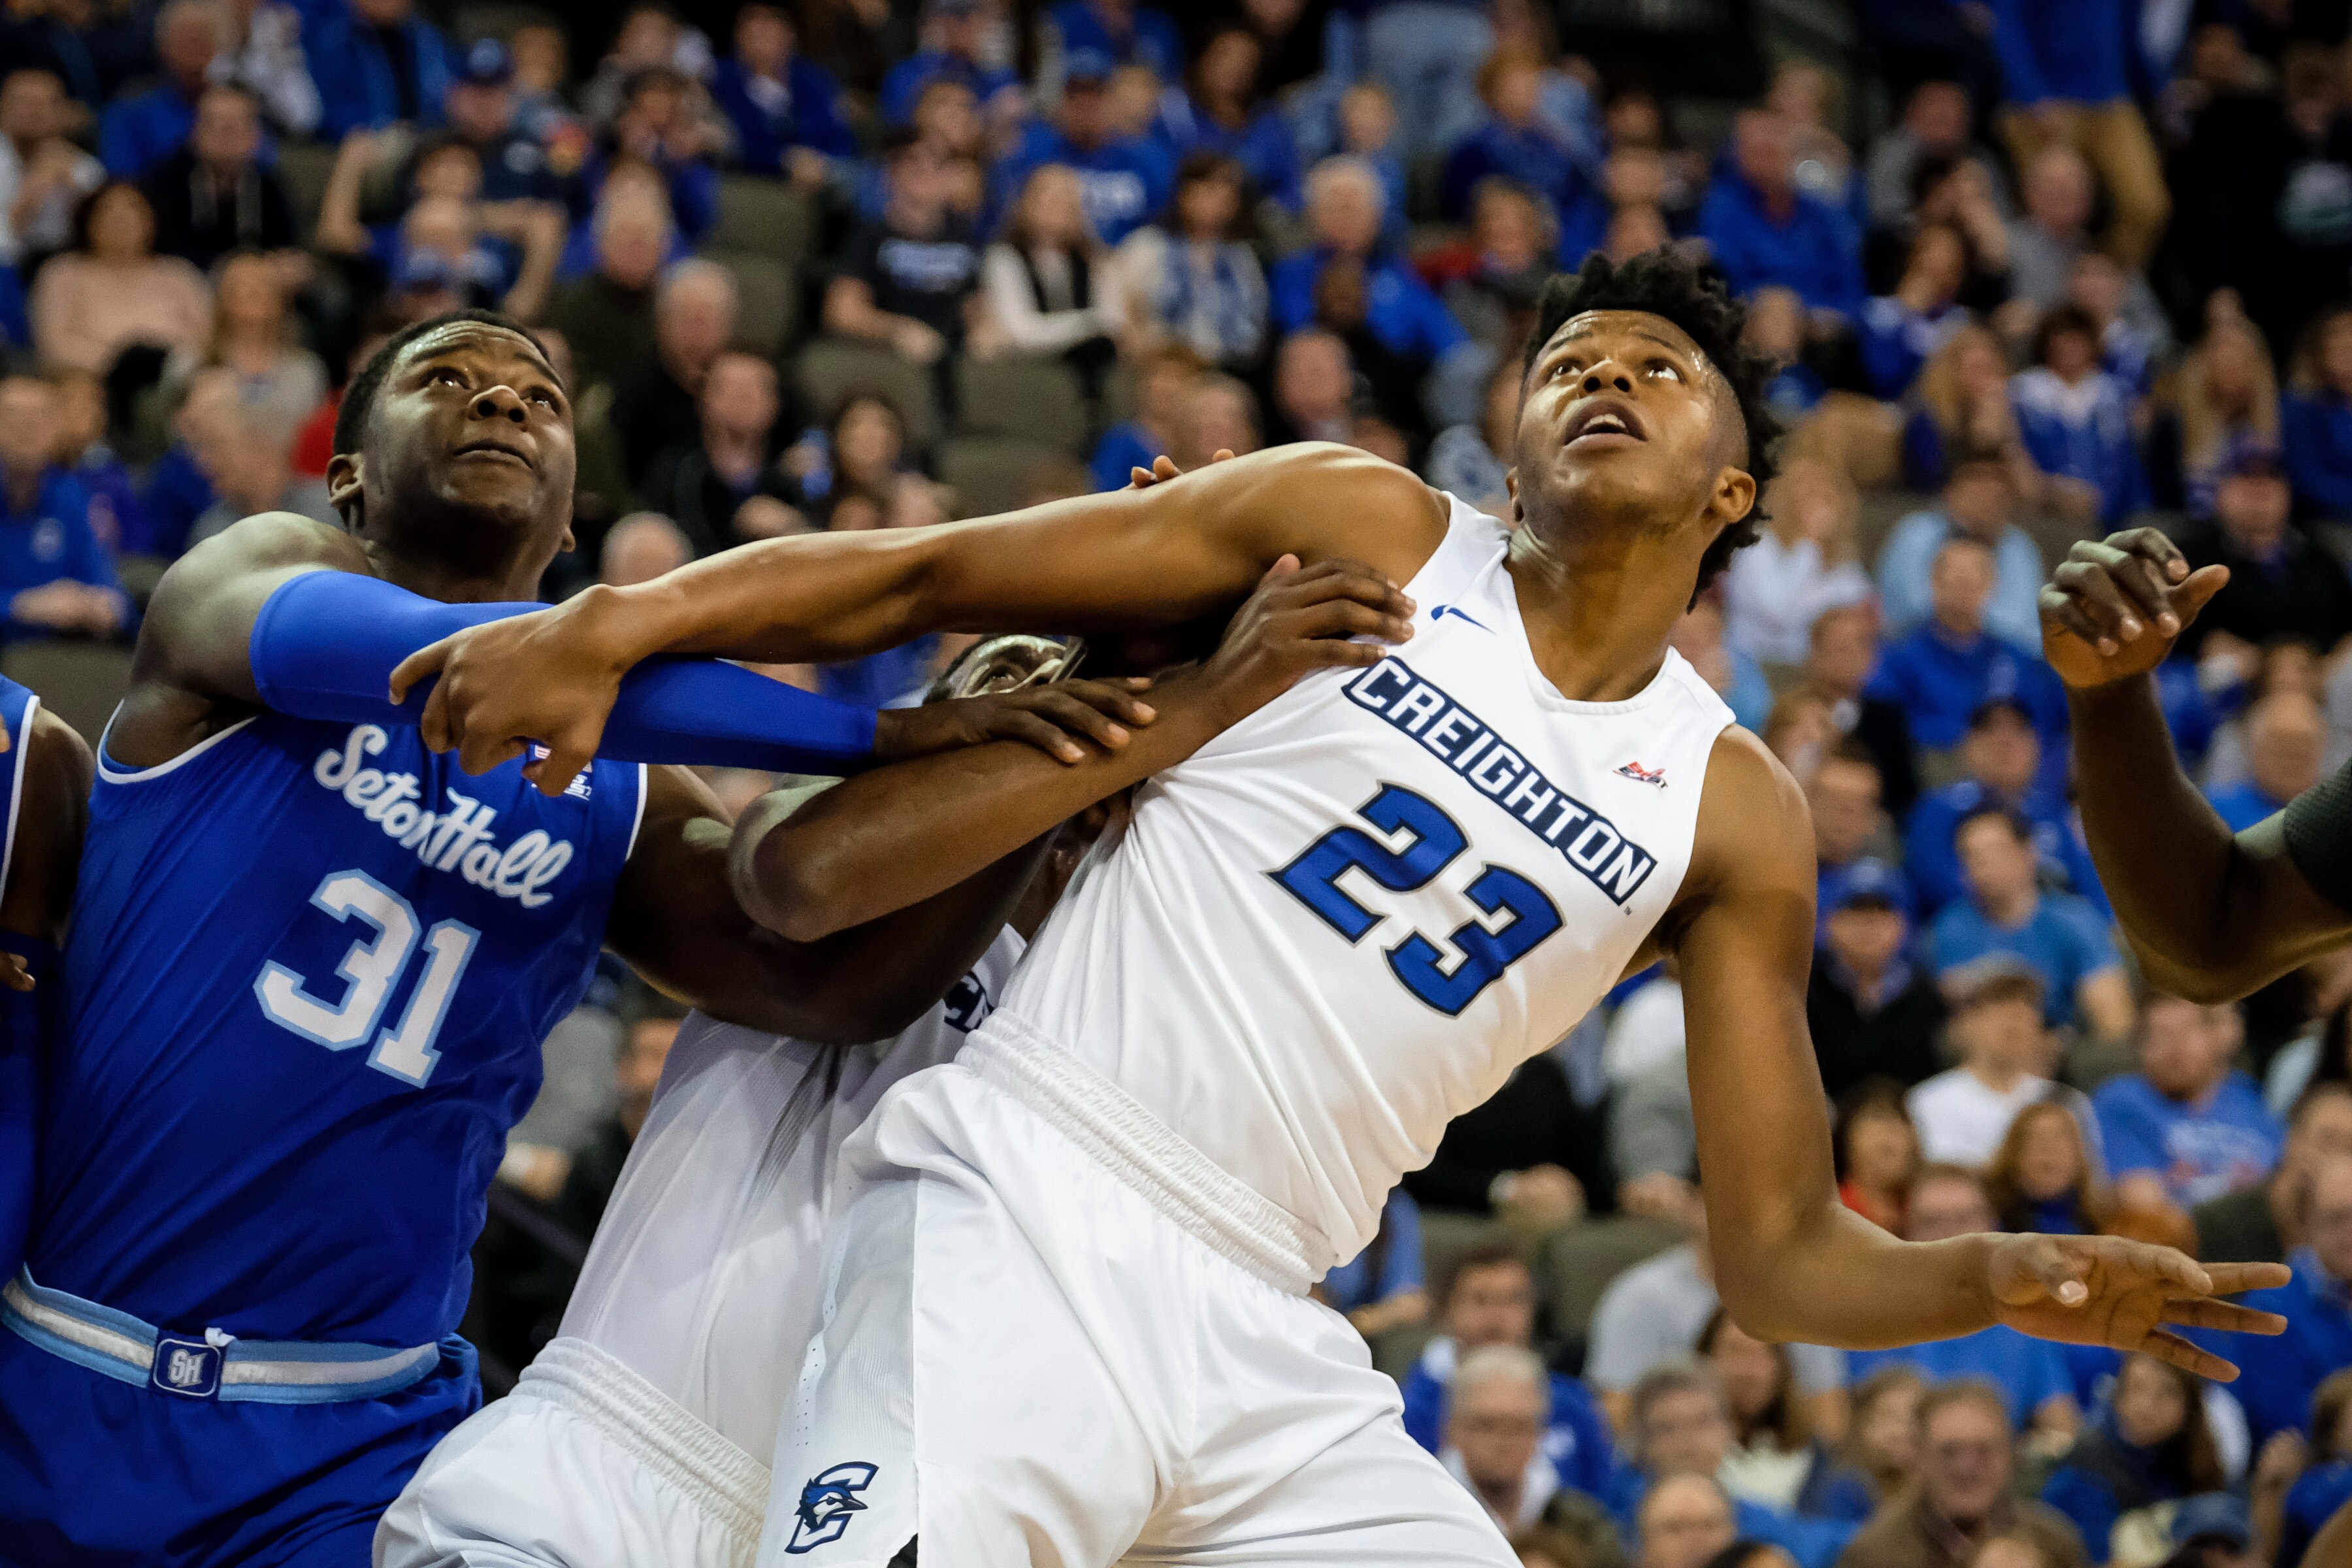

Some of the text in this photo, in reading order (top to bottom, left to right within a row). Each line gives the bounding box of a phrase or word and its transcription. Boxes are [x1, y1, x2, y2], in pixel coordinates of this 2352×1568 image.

[423, 787, 574, 908] Hall
[1343, 655, 1656, 904] CREIGHTON
[253, 868, 482, 1089] 31
[1261, 779, 1567, 1018] 23
[168, 1348, 208, 1388] SH
